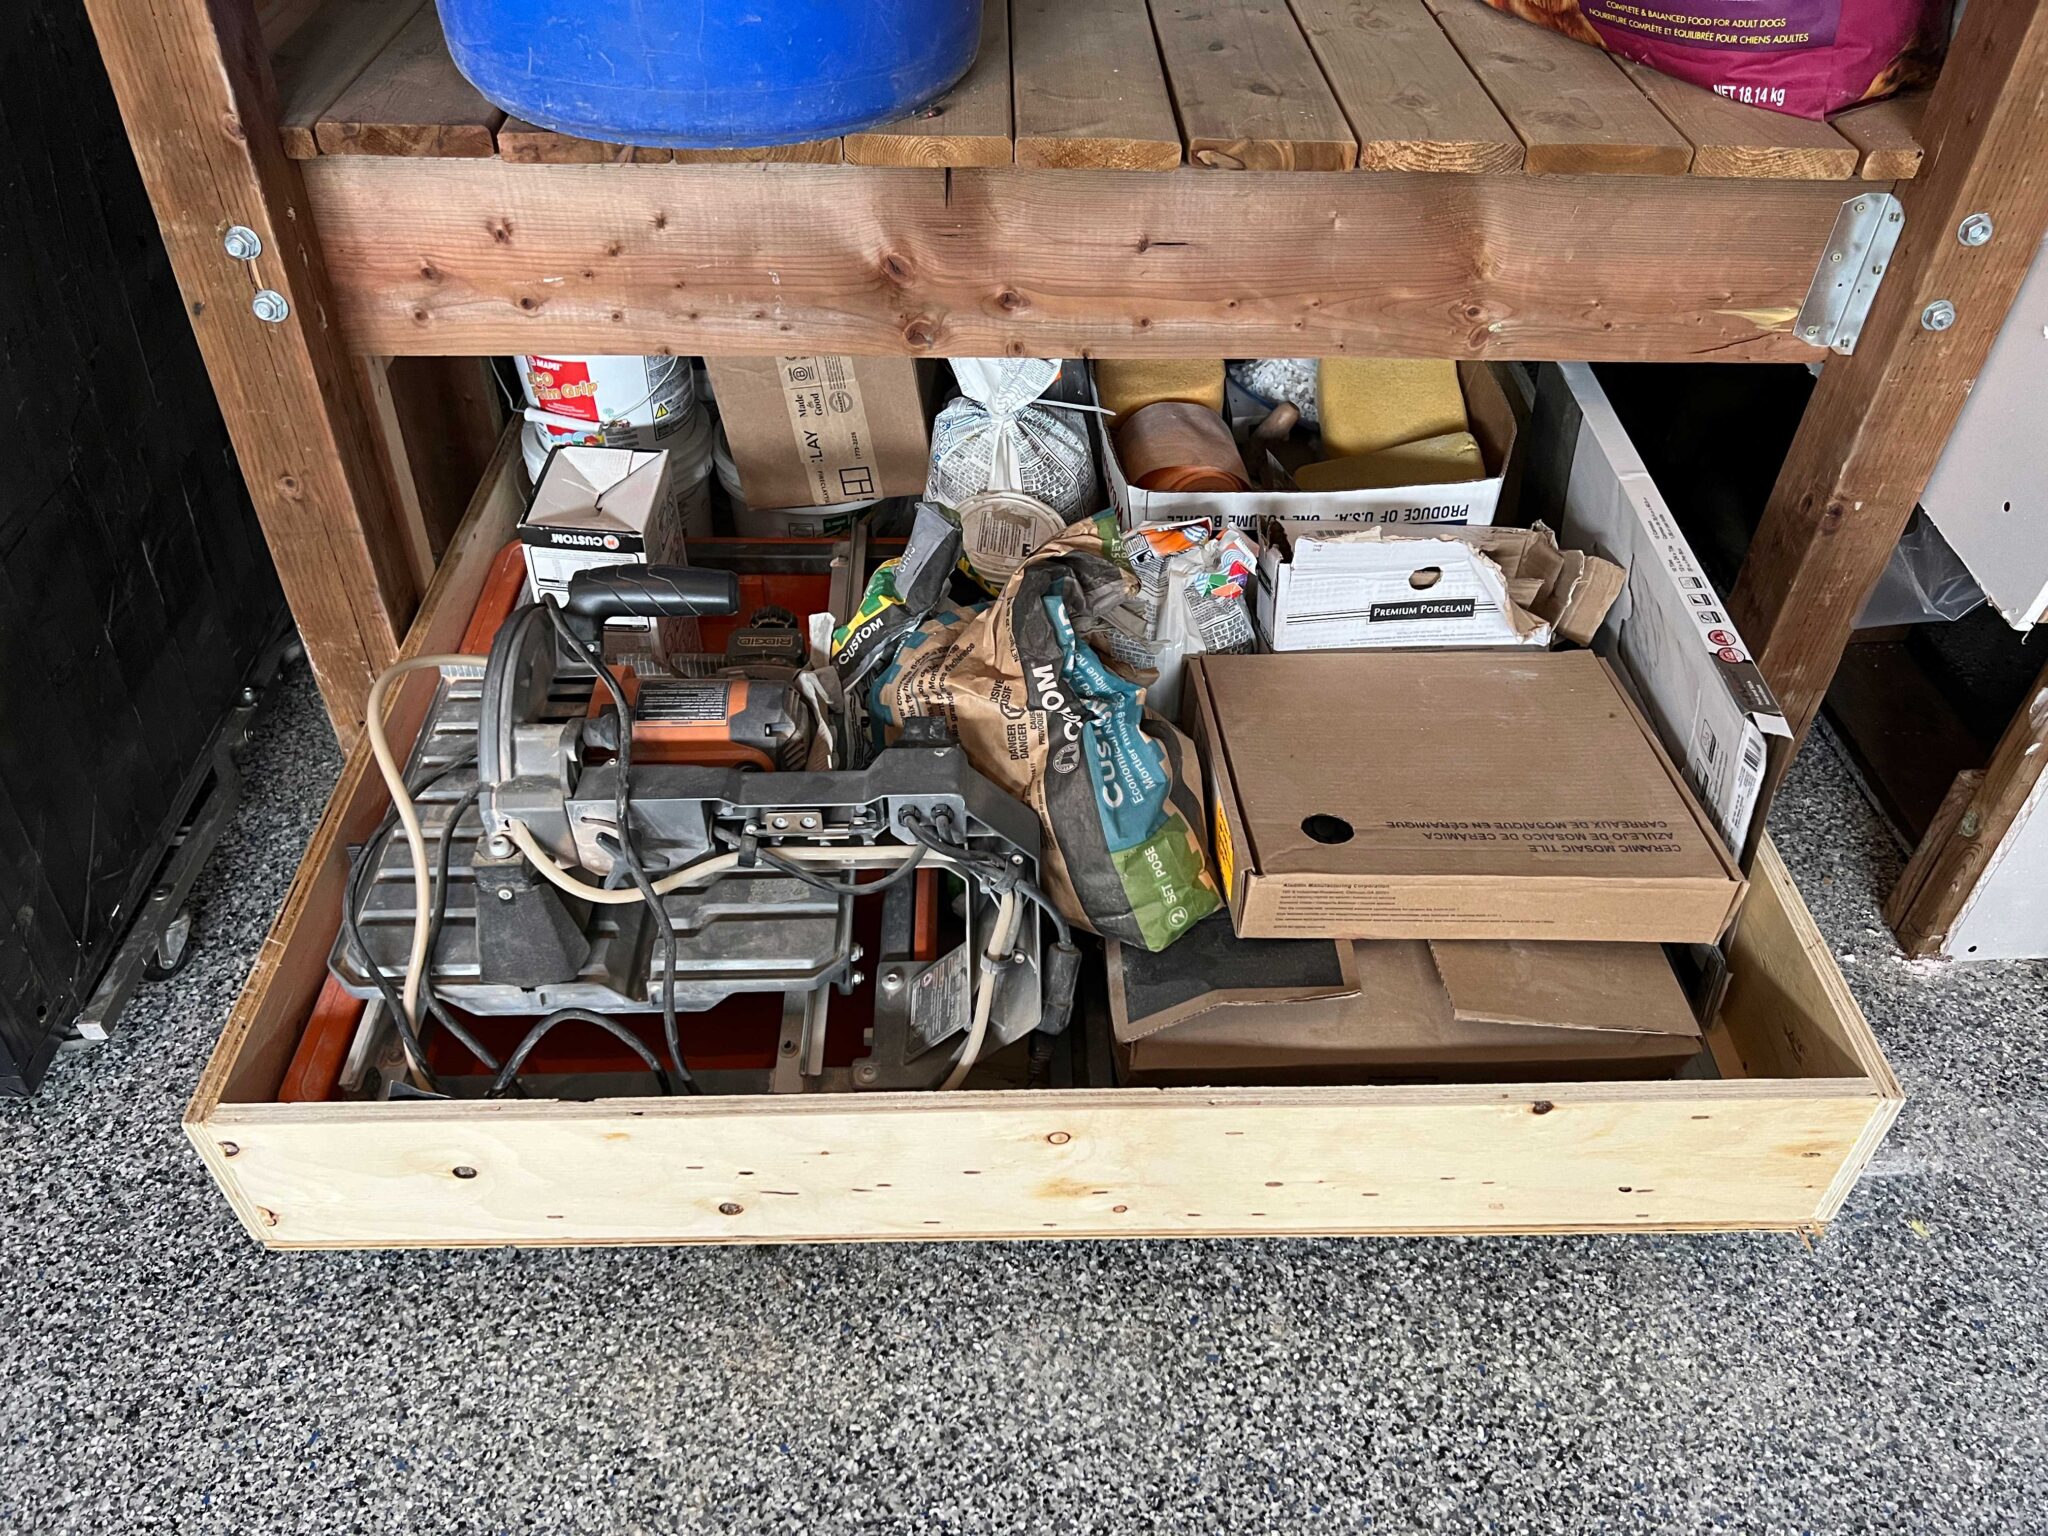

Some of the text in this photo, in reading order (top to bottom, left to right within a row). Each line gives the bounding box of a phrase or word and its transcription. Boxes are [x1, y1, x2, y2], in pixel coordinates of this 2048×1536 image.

[1606, 0, 1786, 28] COMPLETE & BALANCED FOOD FOR ADULT DOGS
[1589, 8, 1809, 44] NOURRITURE COMPLÈTE ET ÉQUILIBRÉE POUR CHIENS ADULTES
[1713, 84, 1785, 107] NET 18.14 kg
[536, 360, 562, 371] MAPEI
[561, 380, 598, 399] Grip
[795, 394, 807, 417] Made
[810, 392, 823, 416] Good
[803, 430, 824, 463] LAY
[1380, 508, 1398, 523] OF
[1403, 504, 1470, 521] PRODUCE
[551, 533, 603, 547] CUSTOM
[737, 636, 793, 647] RIDGID
[838, 617, 885, 666] CUSTOM
[1029, 709, 1038, 730] CAUS
[1006, 723, 1019, 761] DANGER
[1016, 722, 1030, 760] DANGER
[1128, 743, 1154, 790] Mortier
[1386, 820, 1668, 831] CARREAUX DE MOSAÏQUE EN CÉRAMIQUE
[1422, 832, 1674, 842] AZULEJO DE MOSAICO DE CERÁMICA
[1528, 844, 1681, 853] CERAMIC MOSAIC TILE
[1144, 845, 1167, 878] POSE
[1161, 883, 1177, 904] SET
